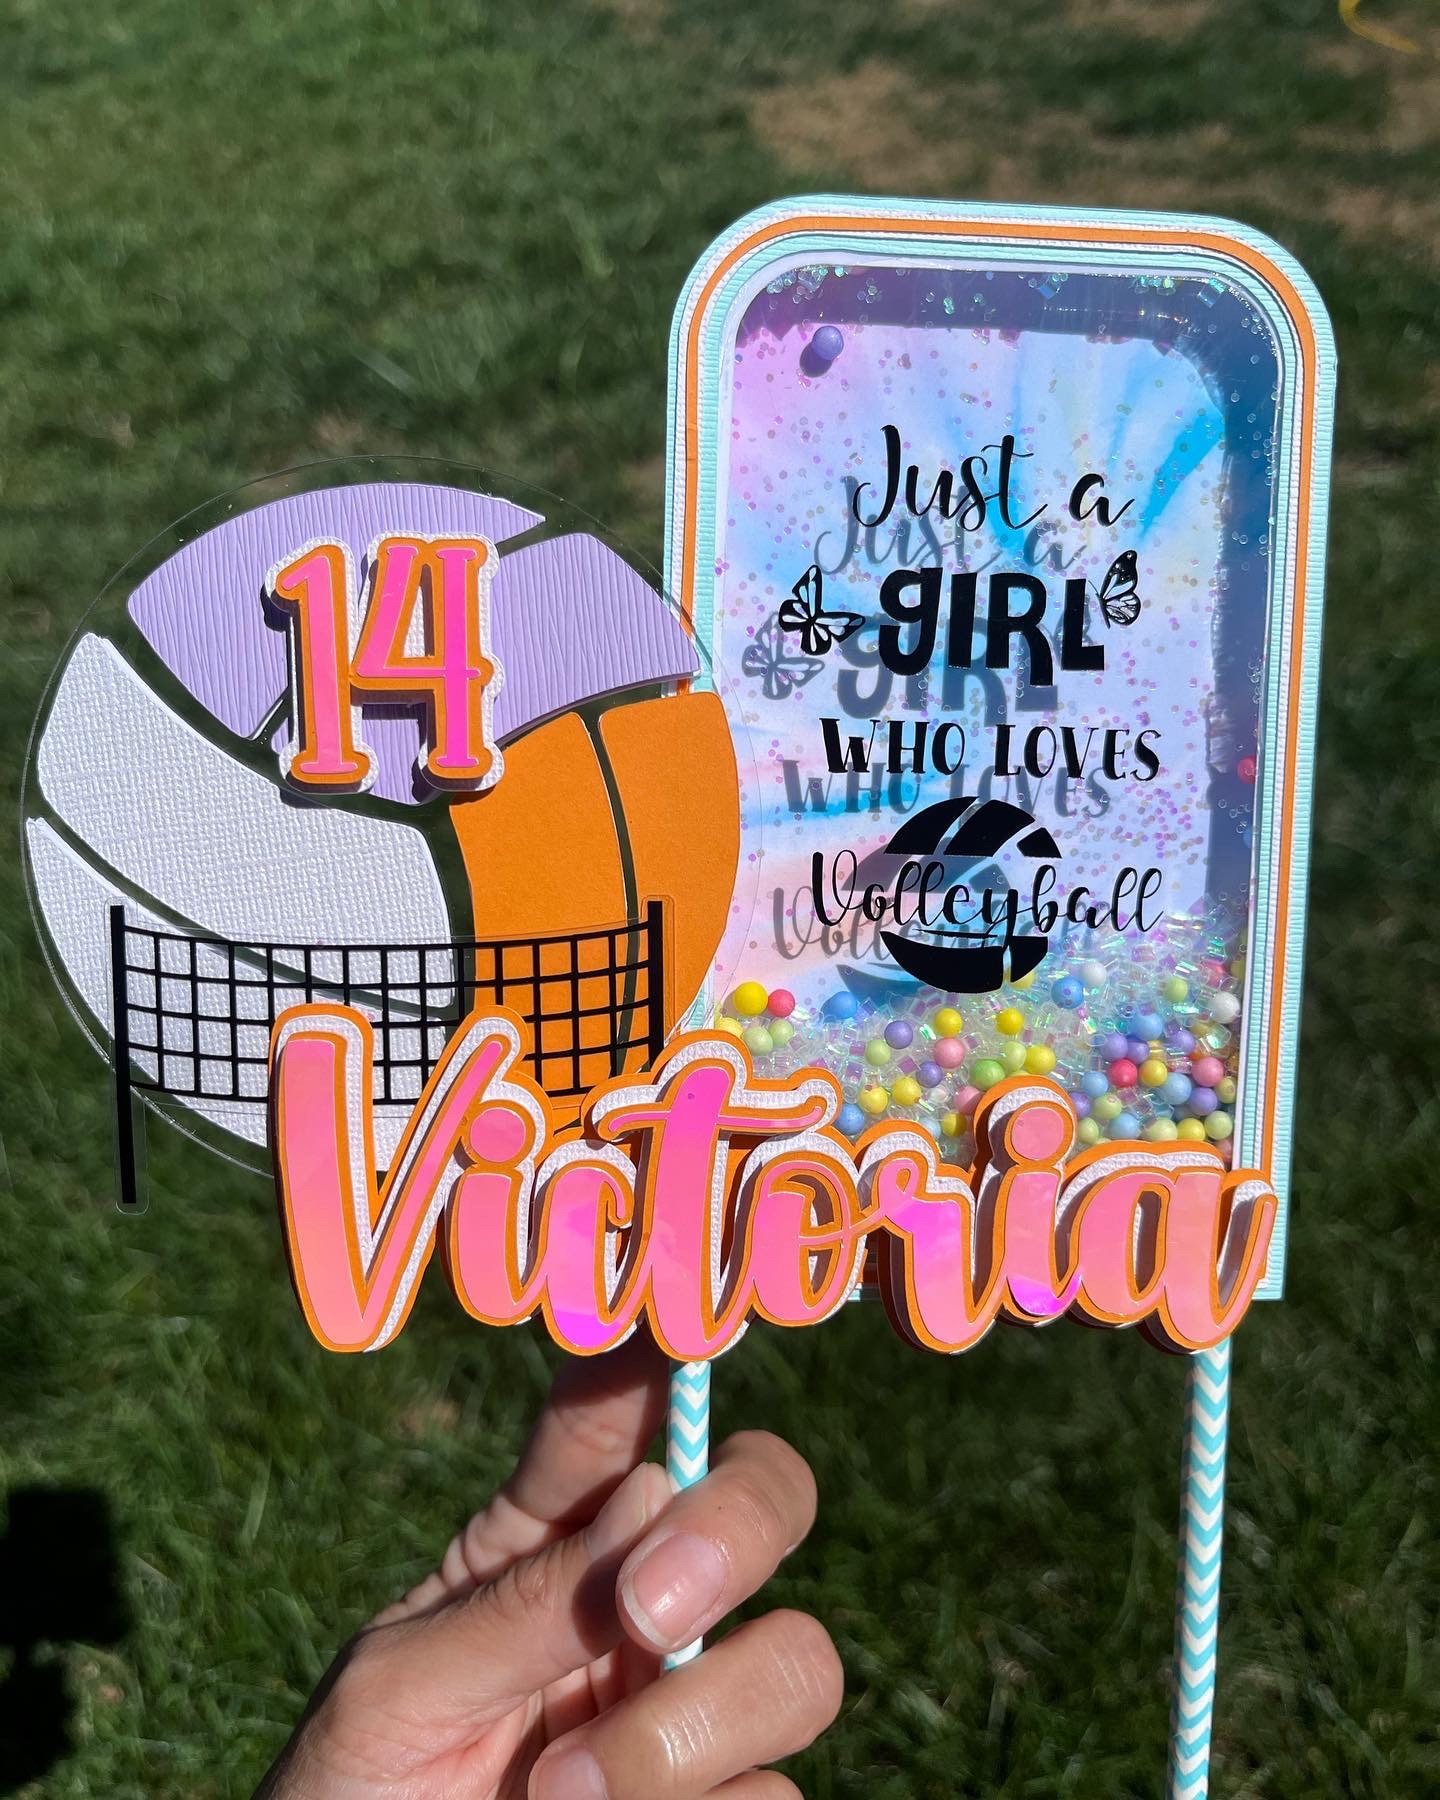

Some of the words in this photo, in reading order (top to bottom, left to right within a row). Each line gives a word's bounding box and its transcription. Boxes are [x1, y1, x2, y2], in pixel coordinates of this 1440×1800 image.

[852, 424, 1048, 532] Just
[1069, 472, 1135, 529] a
[275, 536, 494, 785] 14
[818, 716, 966, 775] WHO
[993, 723, 1161, 782] LOVES
[811, 848, 1164, 956] Volleyball
[271, 1008, 1279, 1360] Victoria
